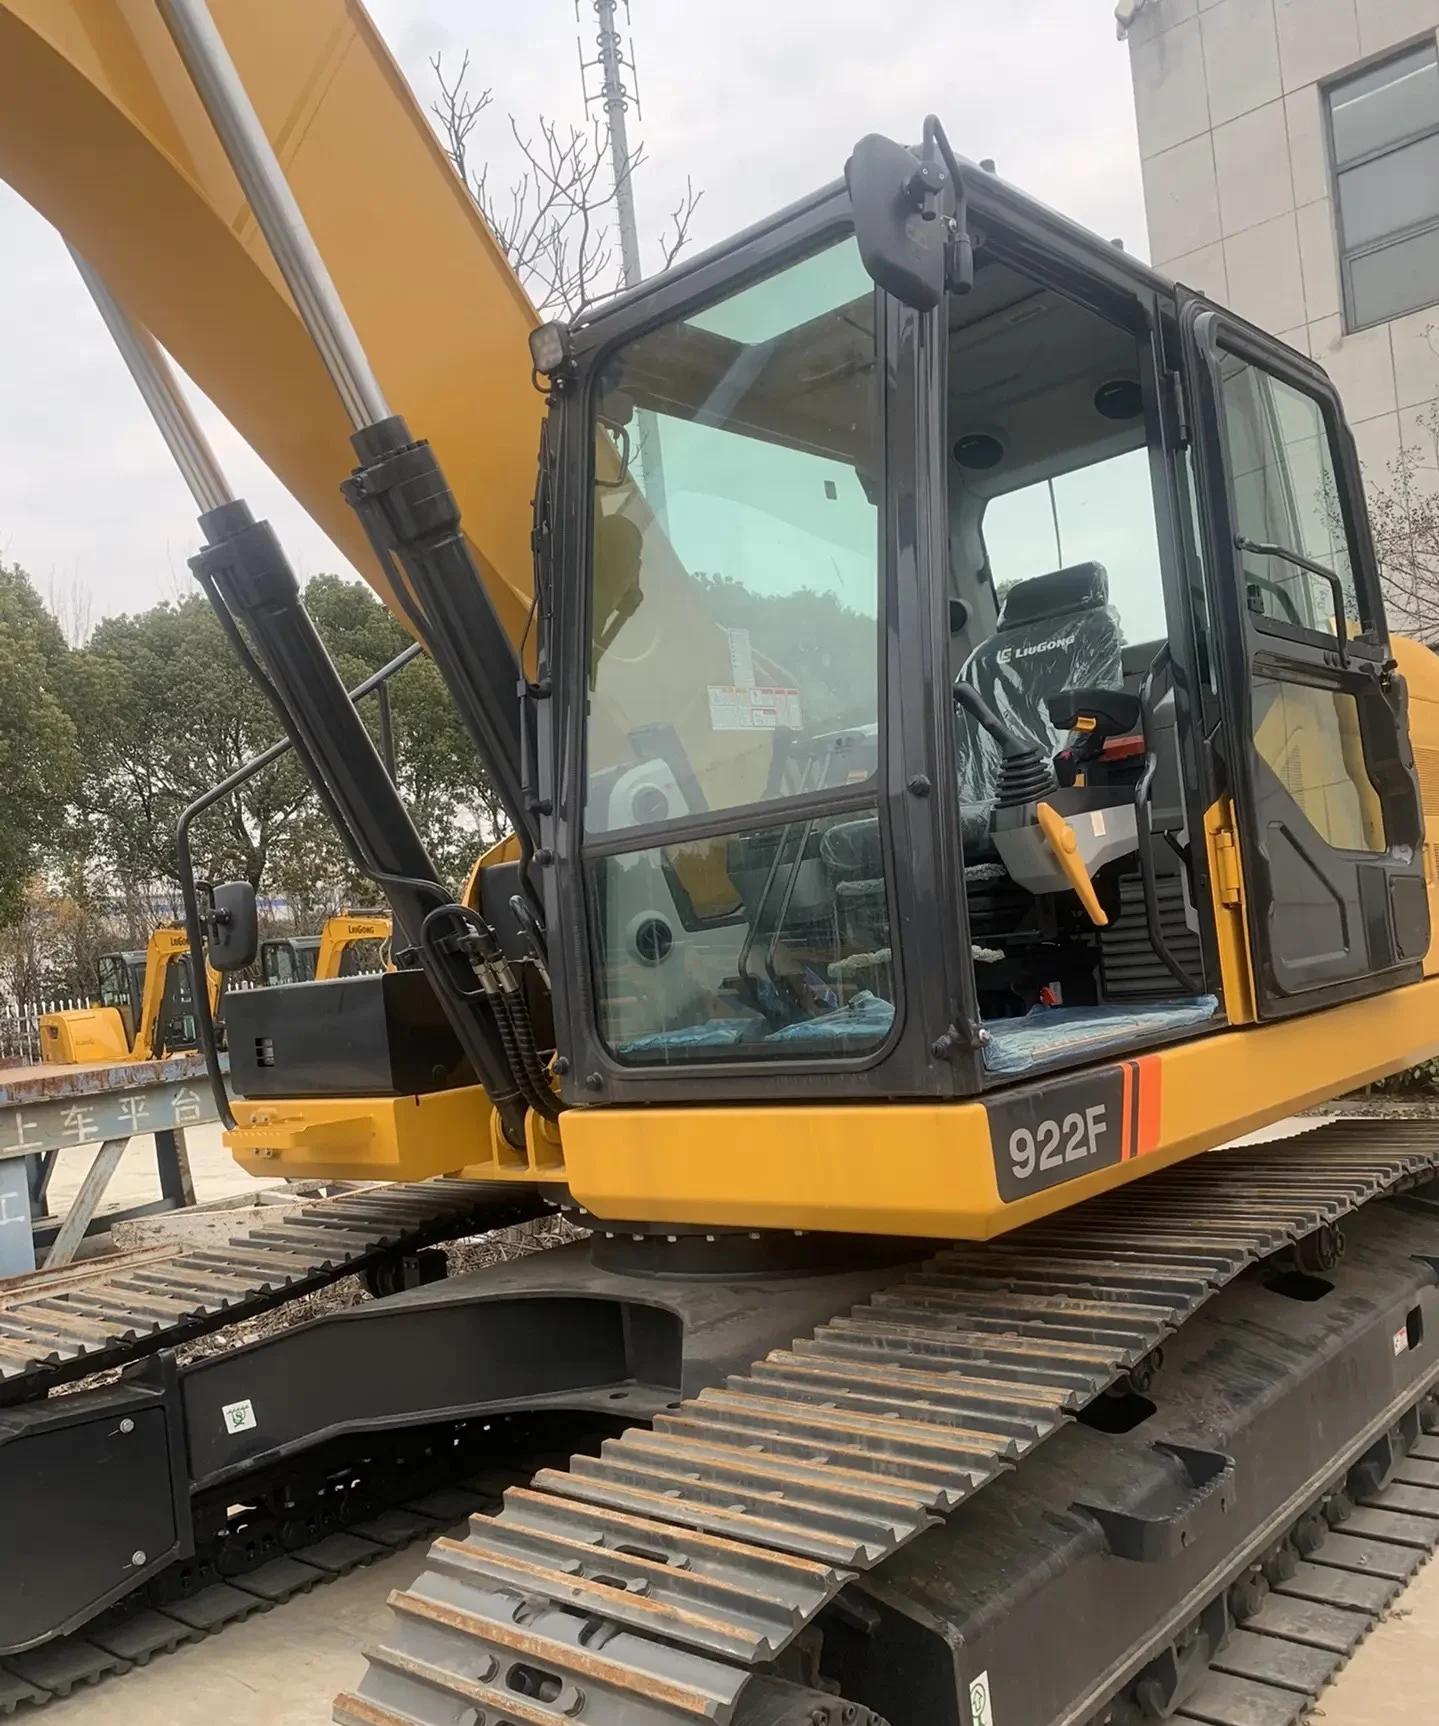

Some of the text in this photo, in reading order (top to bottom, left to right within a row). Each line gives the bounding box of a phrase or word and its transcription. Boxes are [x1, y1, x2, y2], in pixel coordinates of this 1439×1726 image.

[2, 1087, 201, 1151] 上车平台
[1008, 1104, 1108, 1179] 922F
